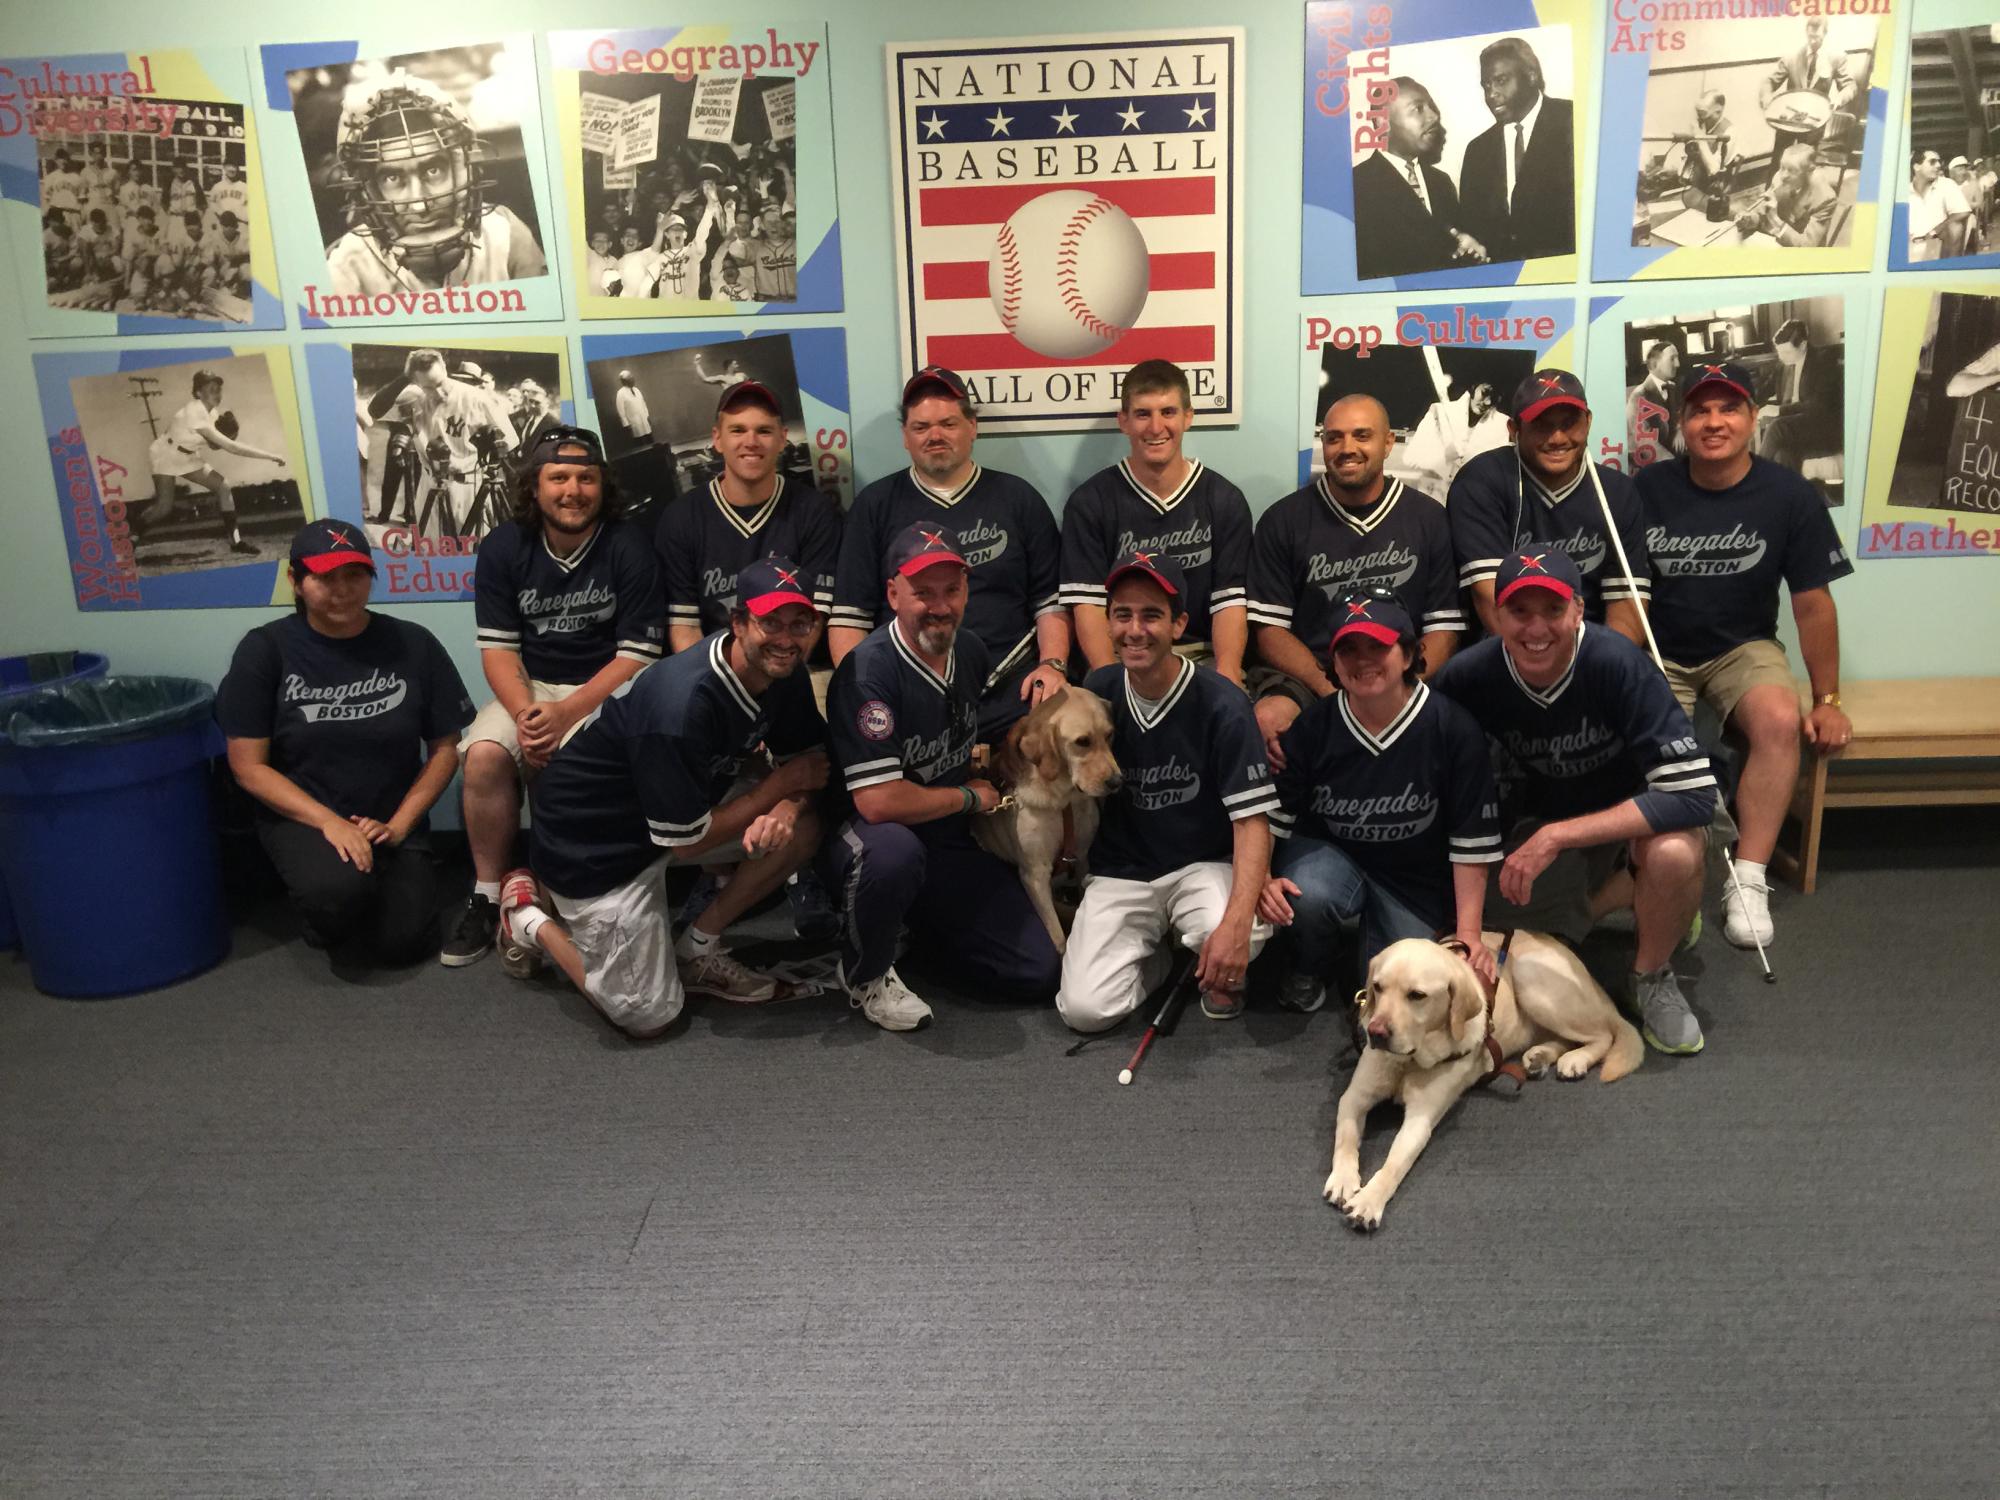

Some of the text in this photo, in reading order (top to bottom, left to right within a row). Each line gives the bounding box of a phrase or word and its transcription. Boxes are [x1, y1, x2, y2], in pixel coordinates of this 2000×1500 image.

[1612, 0, 1892, 23] Communication
[587, 28, 821, 83] Geography
[1609, 24, 1687, 53] Arts
[0, 55, 157, 99] Cultural
[913, 53, 1218, 100] NATIONAL
[1315, 5, 1354, 117] Civil
[1352, 4, 1400, 154] Rights
[0, 97, 177, 139] Diversity
[917, 138, 1218, 183] BASEBALL
[303, 279, 528, 319] Innovation
[1306, 306, 1556, 359] Pop Culture
[963, 367, 1217, 405] ALL OF FE
[1964, 396, 1994, 440] 4
[54, 426, 109, 603] Women's
[96, 455, 142, 603] History
[1307, 540, 1410, 583] Renegades
[1645, 522, 1758, 560] Renegades
[1668, 560, 1742, 575] BOSTON
[517, 578, 609, 618] Renegades
[547, 614, 599, 631] BOSTON
[284, 667, 399, 706] Renegades
[316, 699, 389, 720] BOSTON
[1659, 736, 1699, 758] ABC
[1309, 782, 1431, 826] Renegades
[1339, 823, 1416, 841] BOSTON
